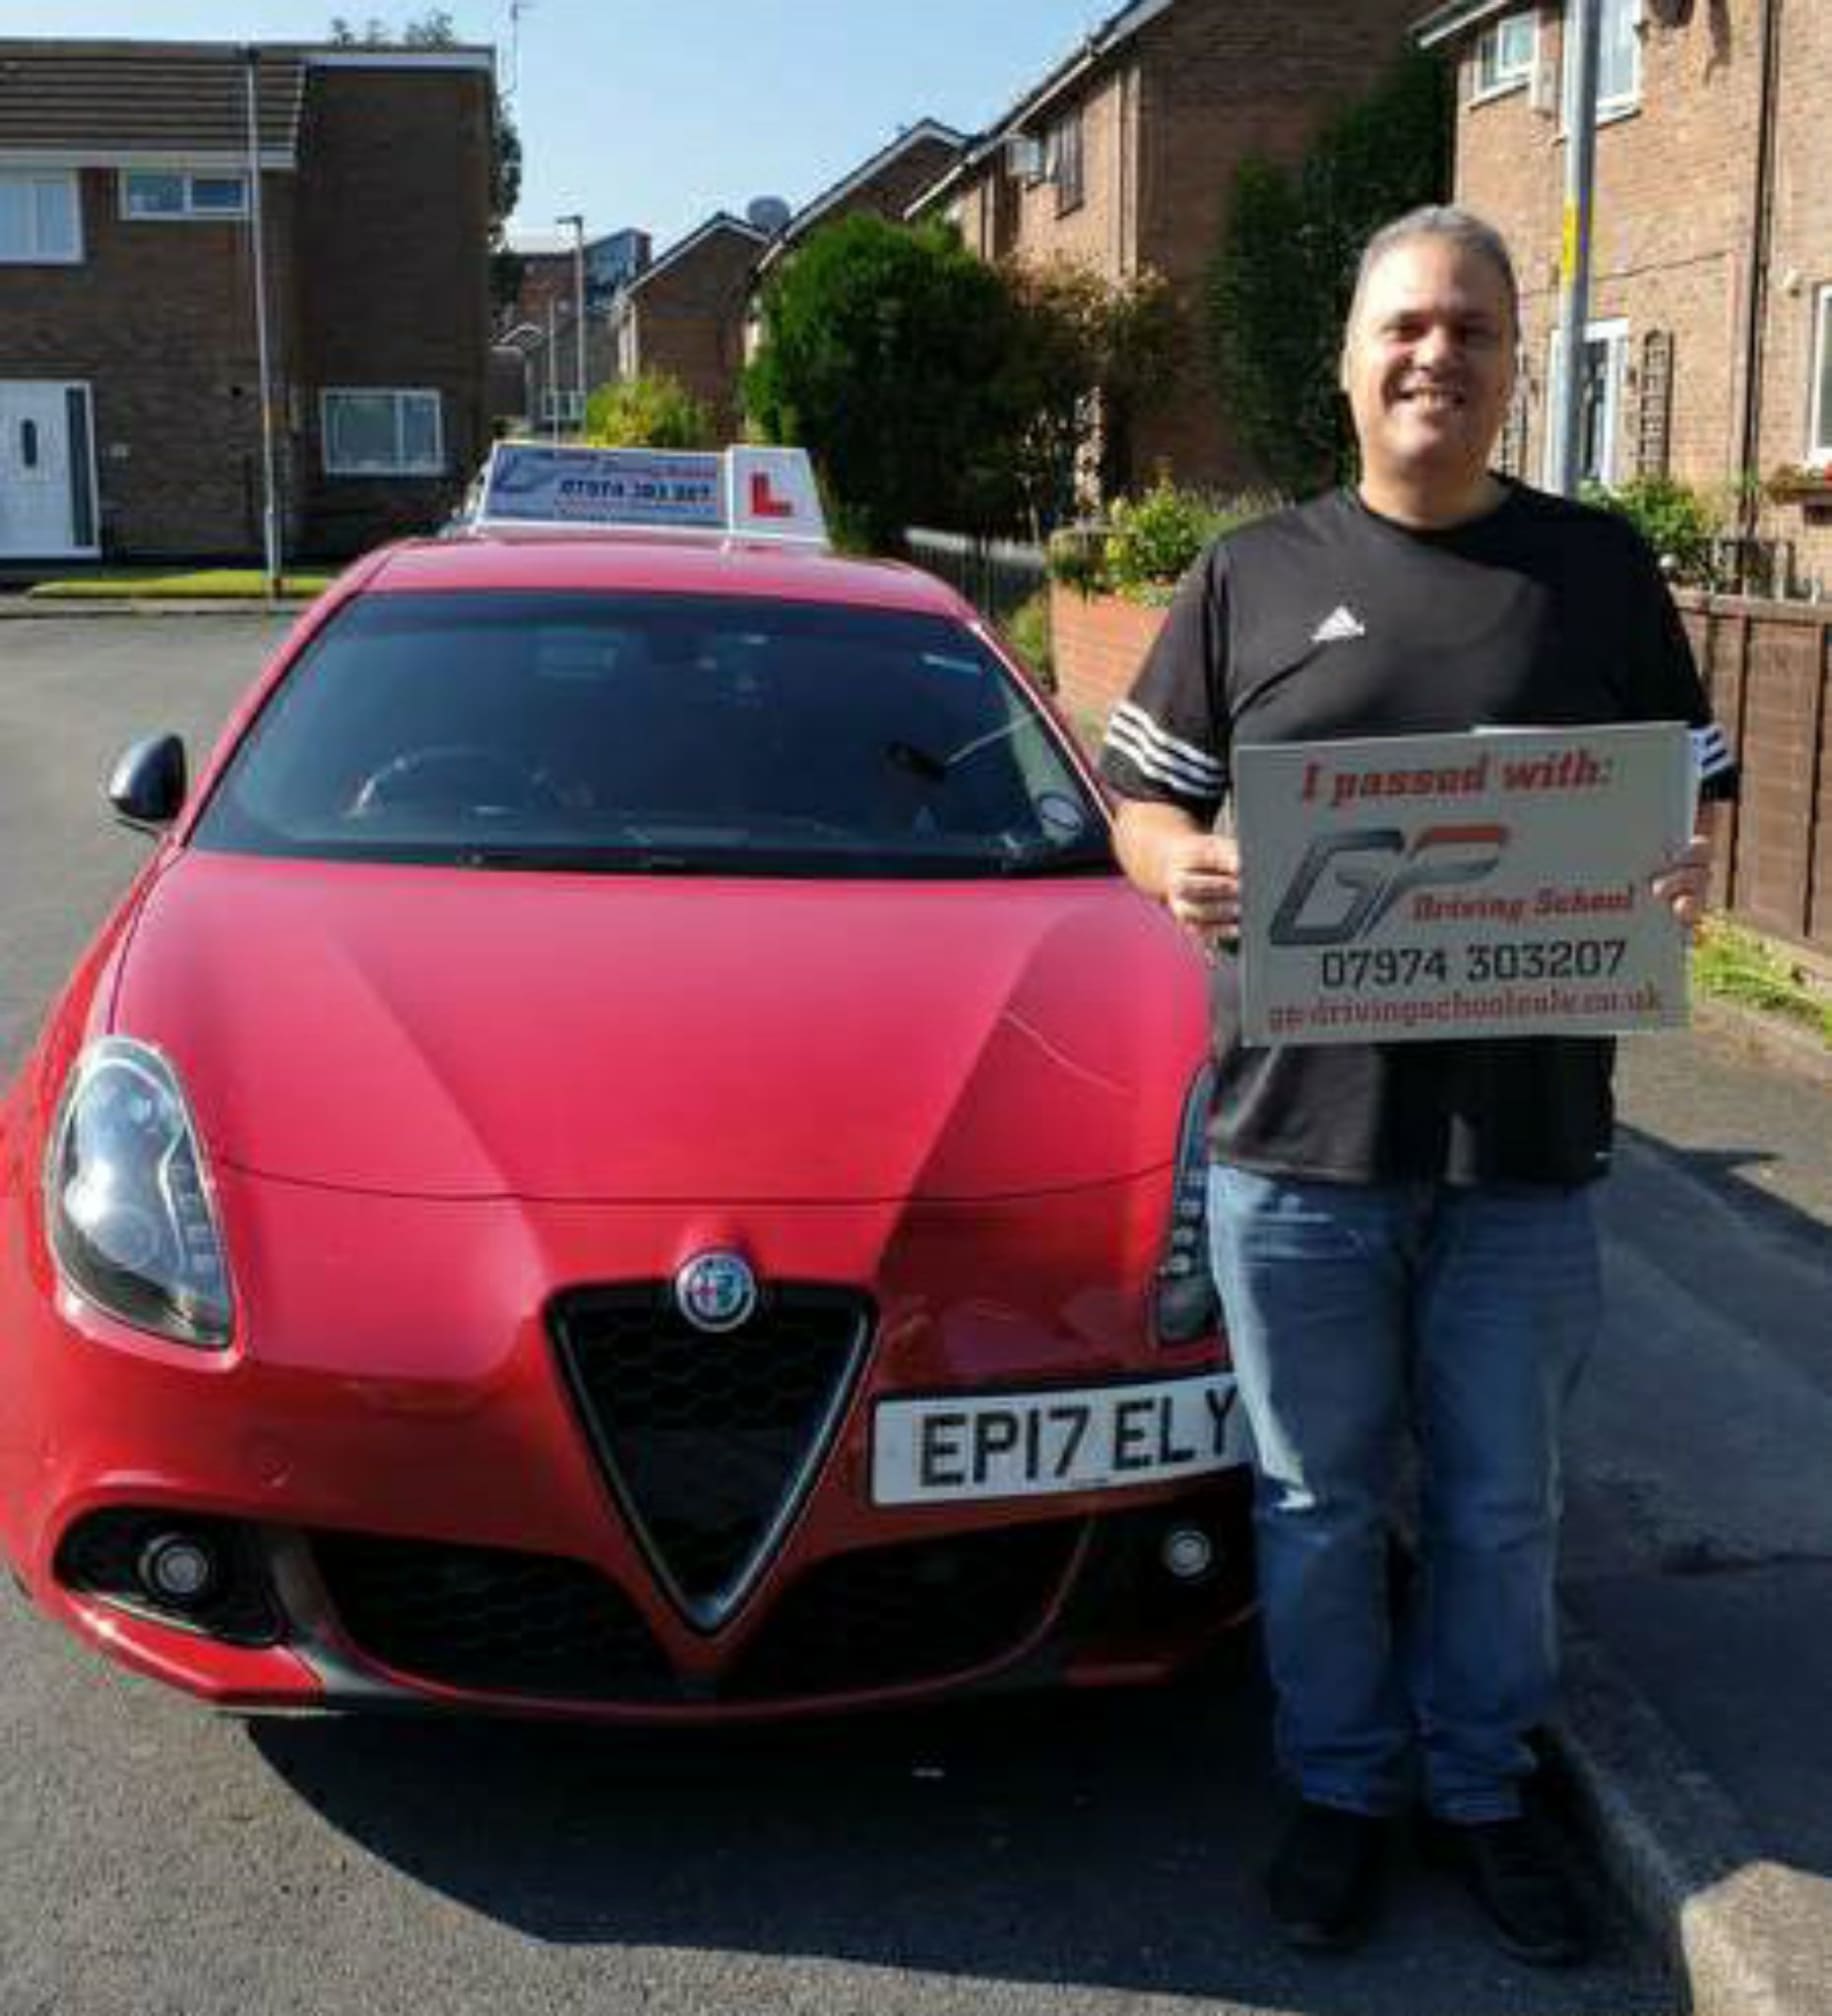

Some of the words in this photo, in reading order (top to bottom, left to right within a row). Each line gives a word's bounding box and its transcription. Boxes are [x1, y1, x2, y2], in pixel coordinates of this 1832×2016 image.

[752, 471, 794, 518] L
[1303, 766, 1319, 800] I
[1330, 754, 1488, 806] passed
[1503, 749, 1613, 788] with:
[1269, 823, 1511, 946] GP
[1413, 892, 1524, 924] Driving
[1535, 883, 1635, 915] School
[1322, 945, 1448, 988] 07974
[1467, 940, 1628, 984] 303207
[921, 1405, 1090, 1487] EP17
[1113, 1384, 1238, 1472] ELY
